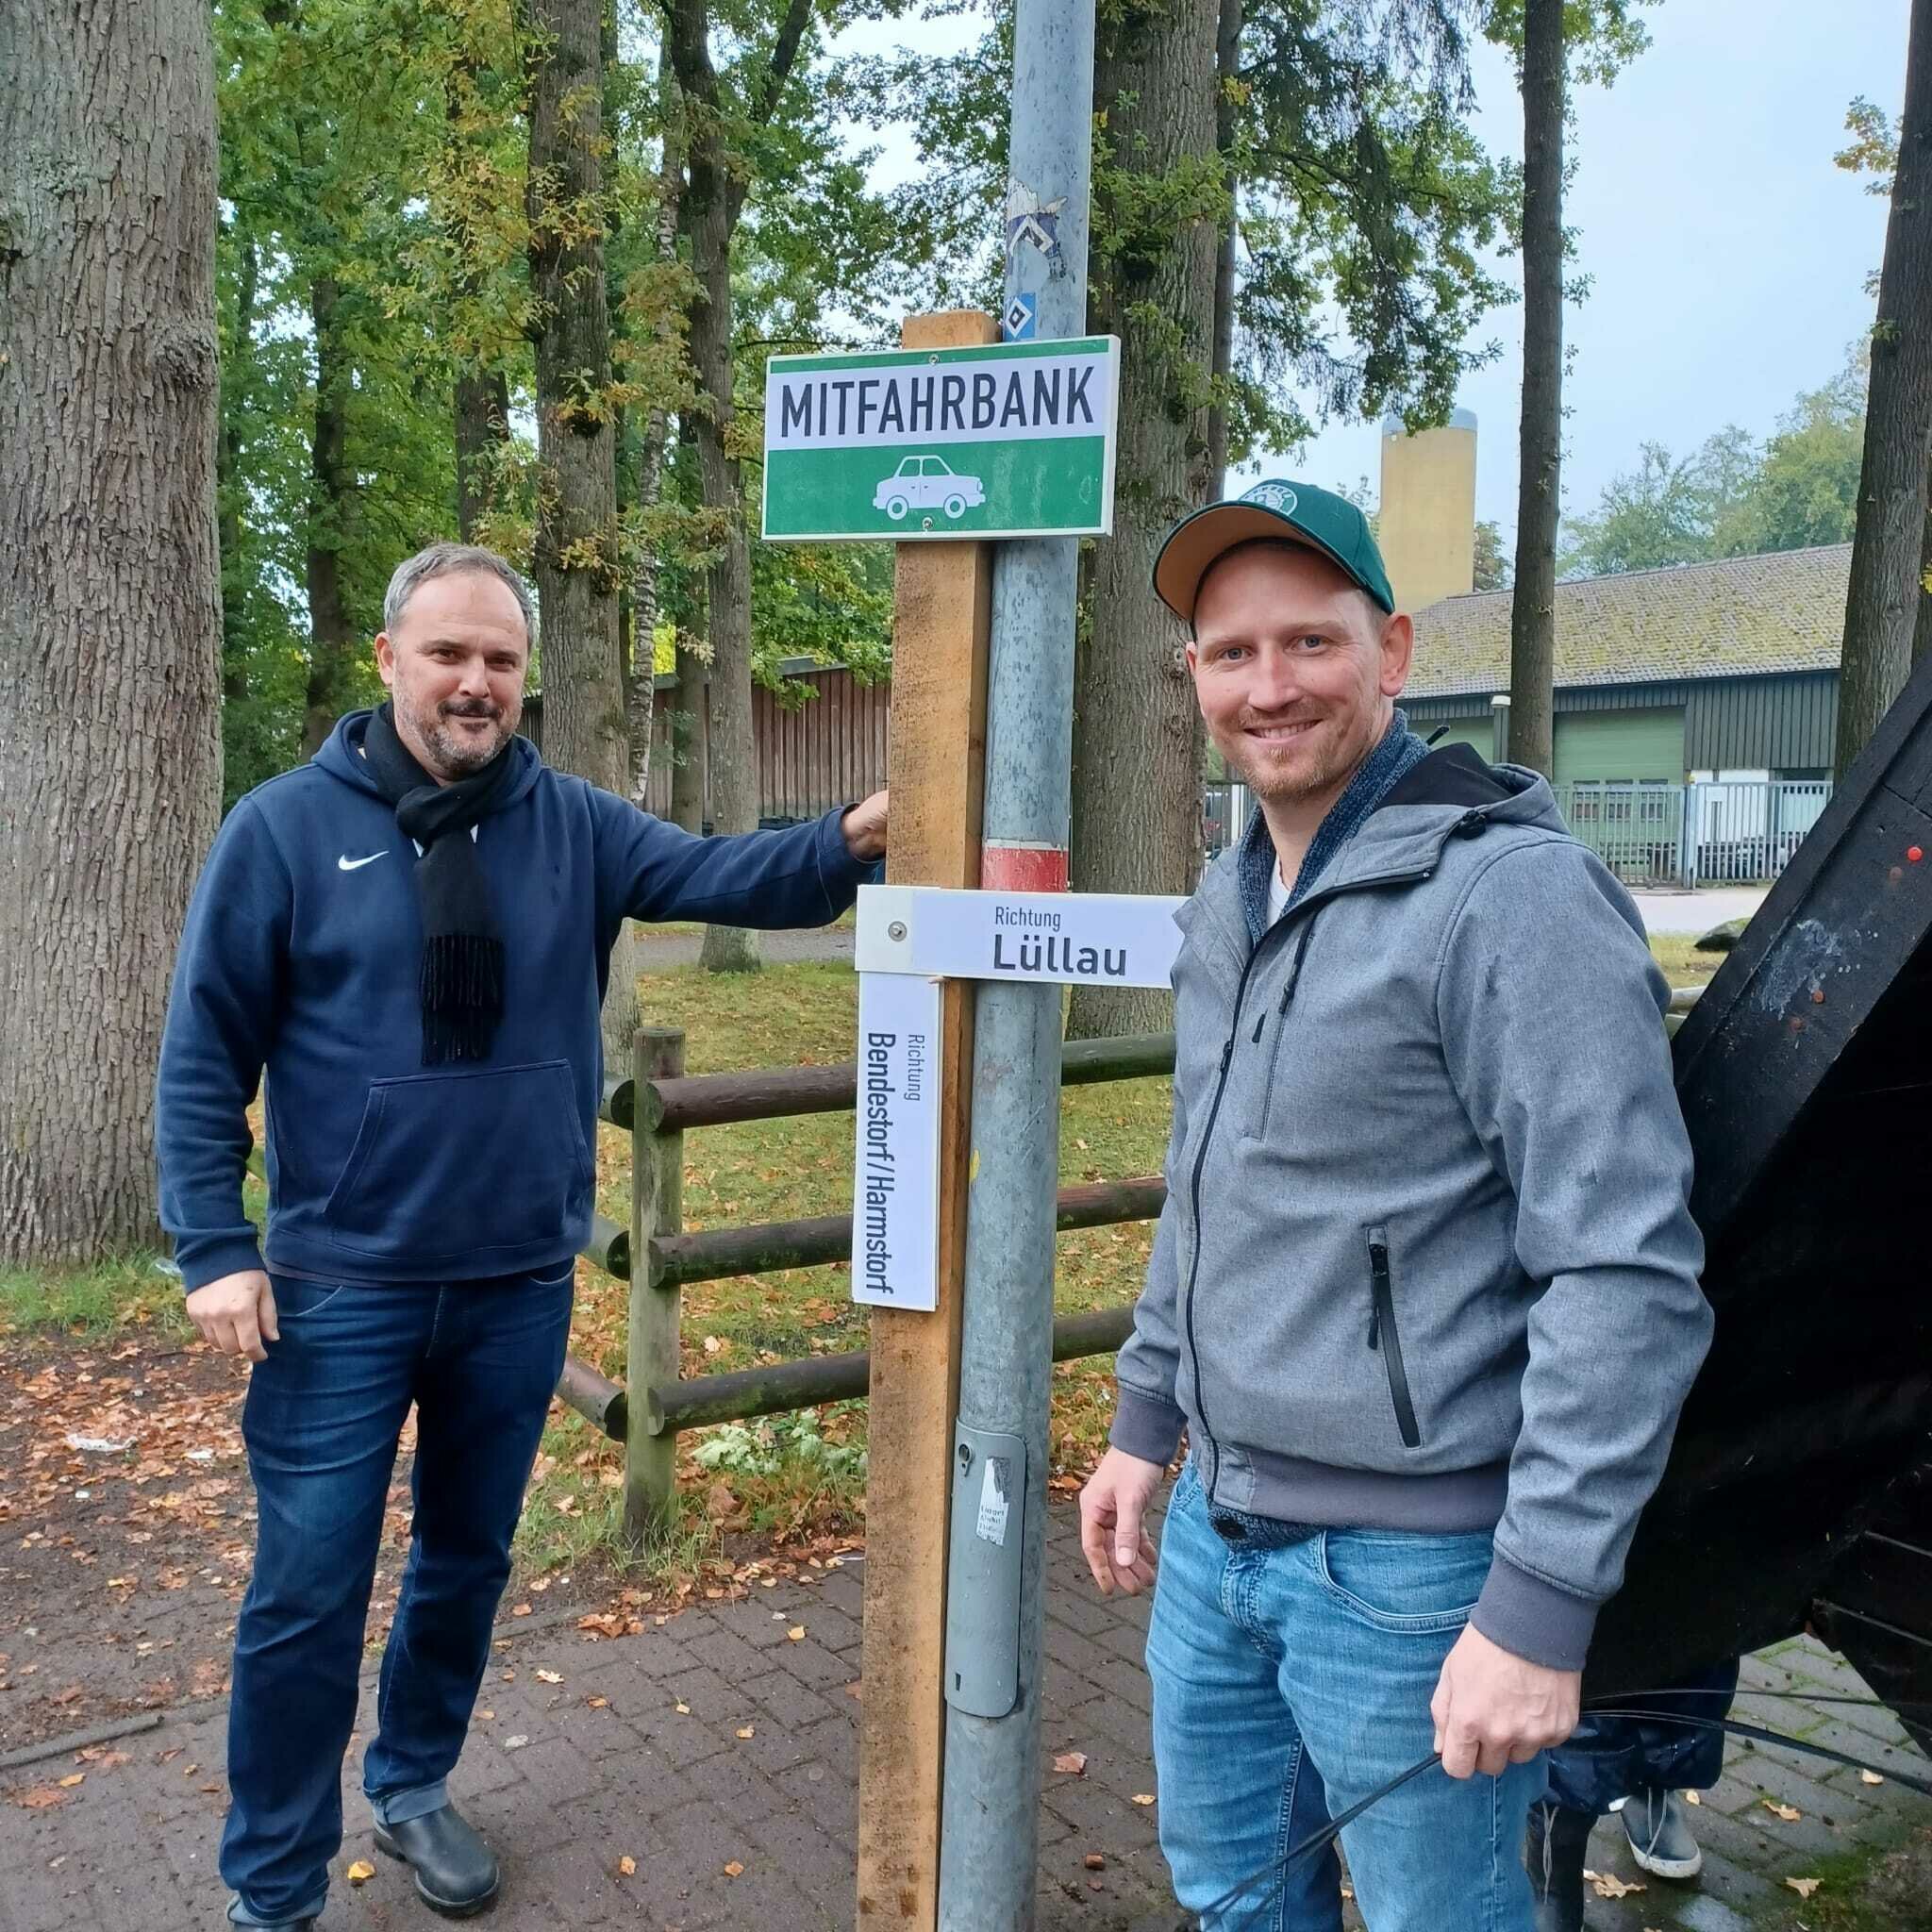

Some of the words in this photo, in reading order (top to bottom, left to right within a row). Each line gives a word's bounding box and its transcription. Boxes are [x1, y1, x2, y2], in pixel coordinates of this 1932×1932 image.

[781, 366, 1095, 438] MITFAHRBANK
[994, 906, 1062, 932] Richtung
[993, 934, 1127, 976] Lüllau
[904, 1034, 925, 1102] Richtung
